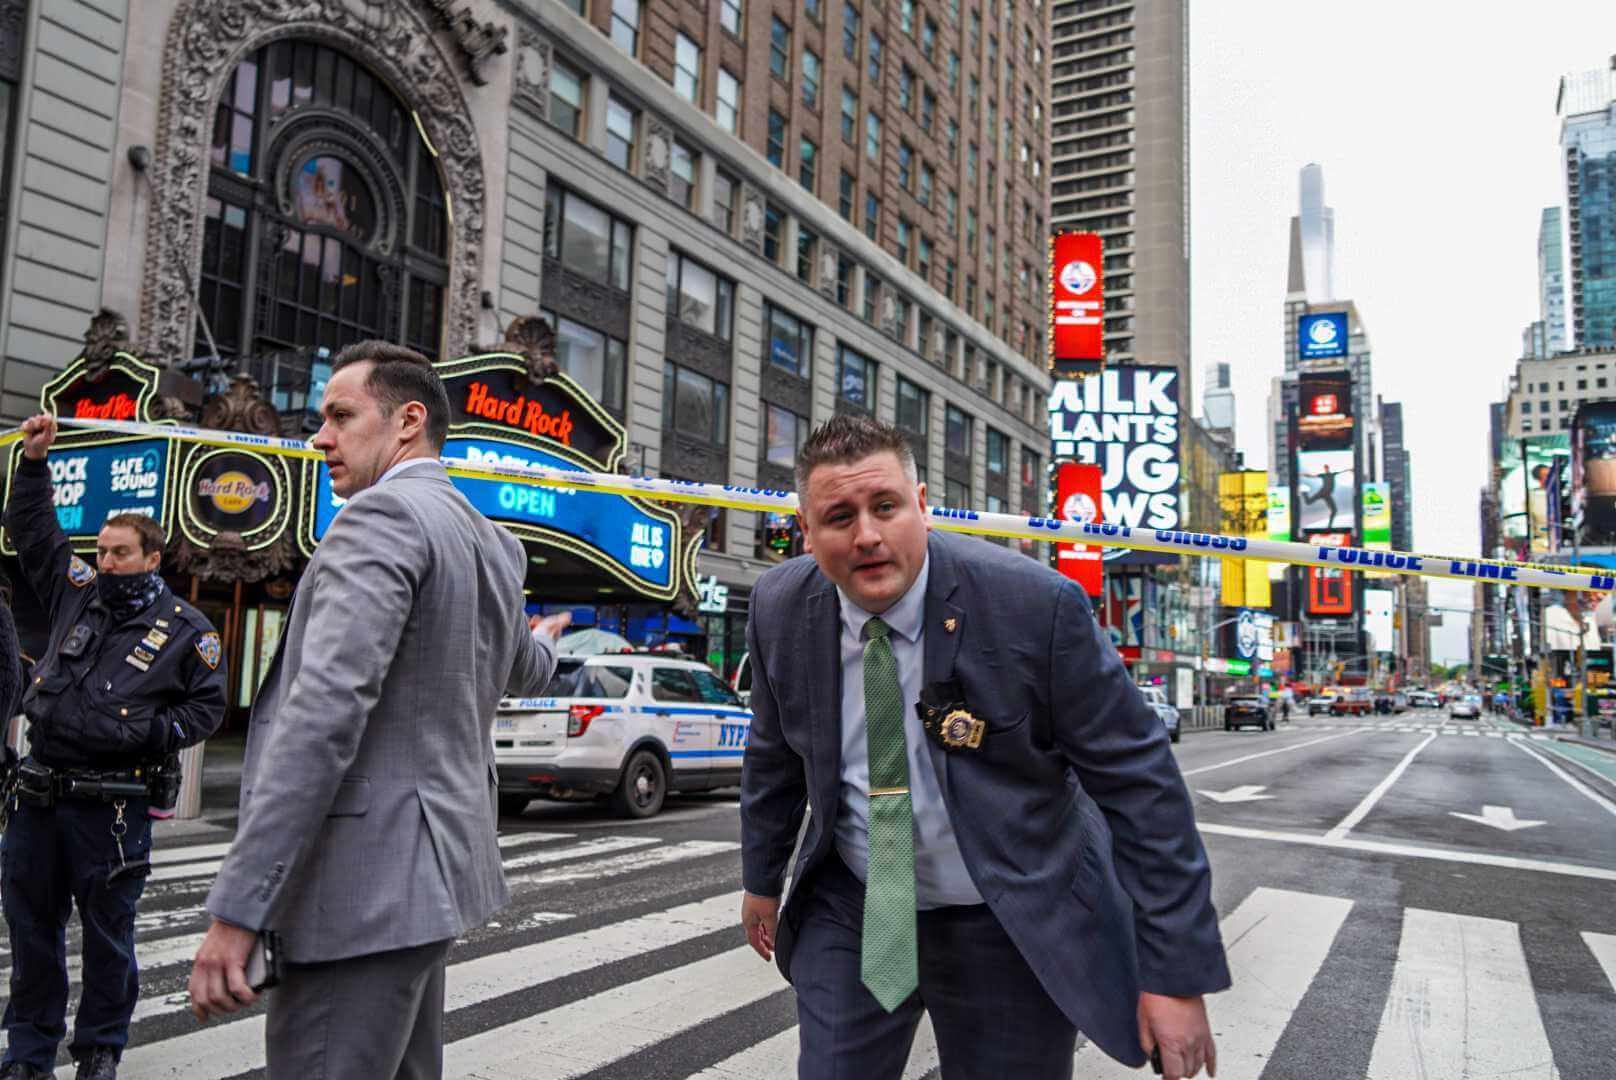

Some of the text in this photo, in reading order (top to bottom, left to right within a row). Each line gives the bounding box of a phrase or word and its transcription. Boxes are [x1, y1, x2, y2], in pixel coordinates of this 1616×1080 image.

[75, 393, 136, 422] Hard Roc
[466, 381, 573, 446] Hard Rock
[1051, 413, 1178, 444] LANTS
[111, 457, 144, 476] SAFE
[52, 481, 86, 506] HOP
[111, 471, 159, 492] SOUND
[198, 478, 269, 502] Hard Rock
[499, 484, 556, 518] OPEN
[1102, 492, 1179, 530] WS
[1318, 546, 1423, 570] POLICE
[1449, 561, 1518, 581] LINE
[519, 698, 557, 708] POLICE
